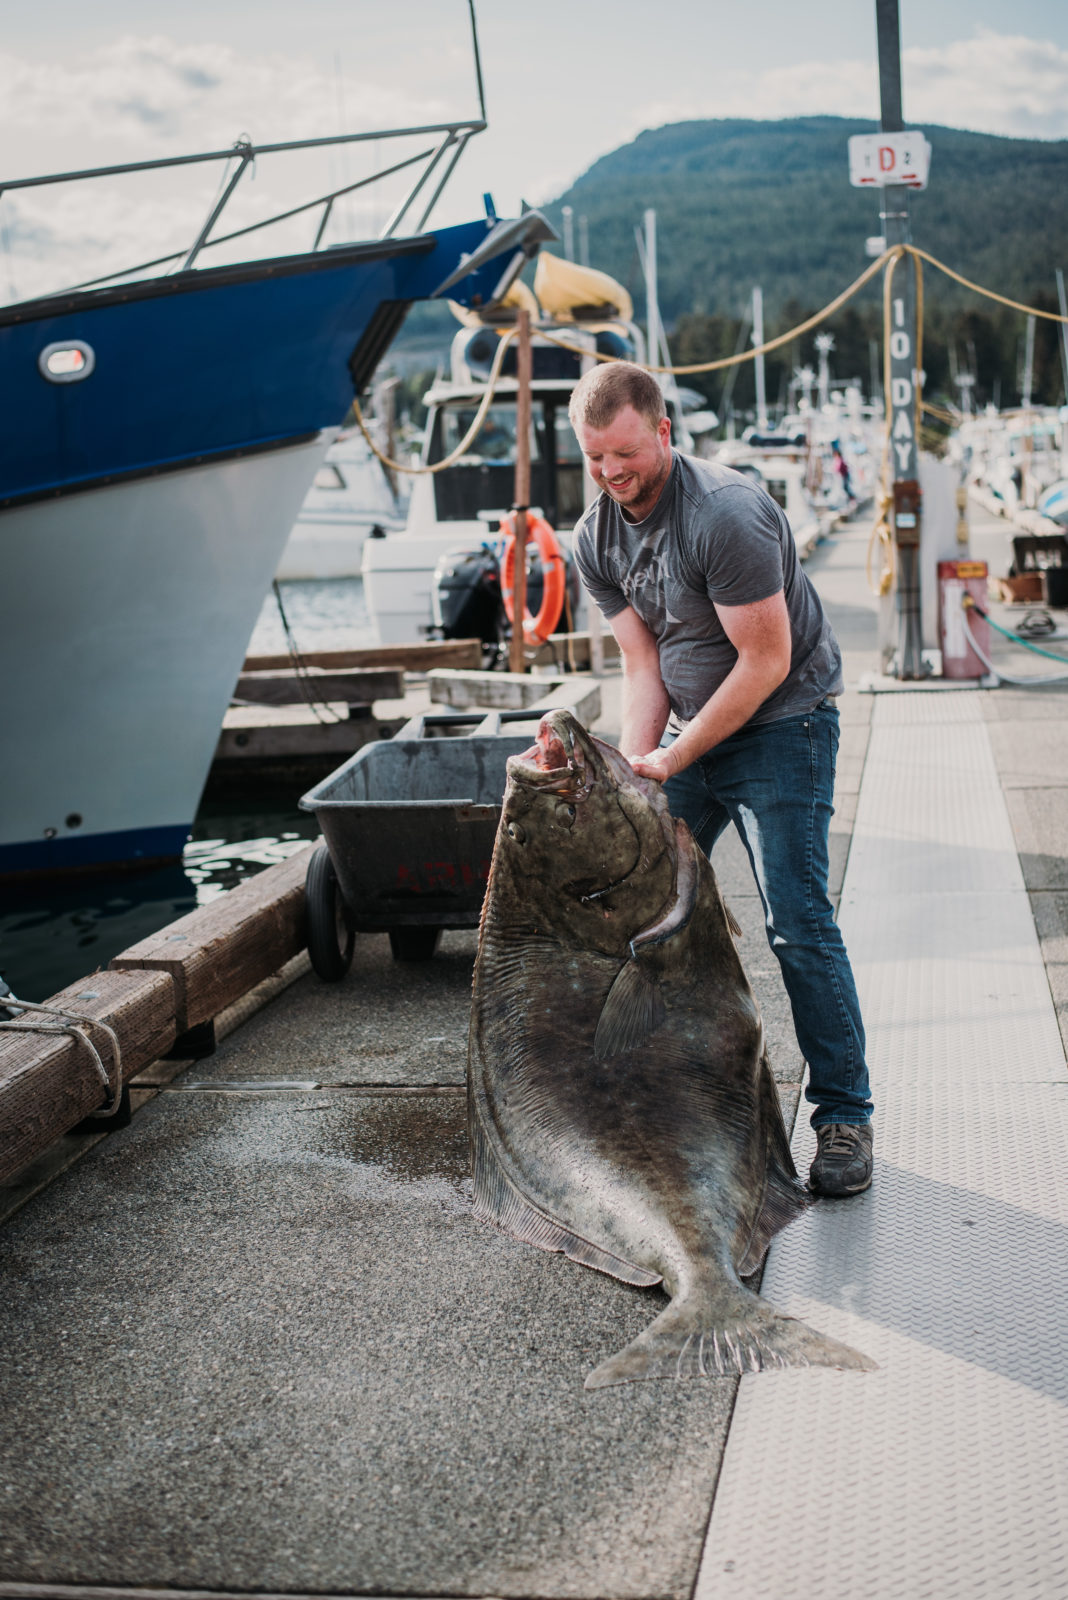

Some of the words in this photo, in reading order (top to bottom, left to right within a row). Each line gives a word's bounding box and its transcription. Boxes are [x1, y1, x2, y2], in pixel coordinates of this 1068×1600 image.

[879, 146, 896, 172] D
[891, 298, 910, 360] 10
[892, 378, 912, 471] DAY
